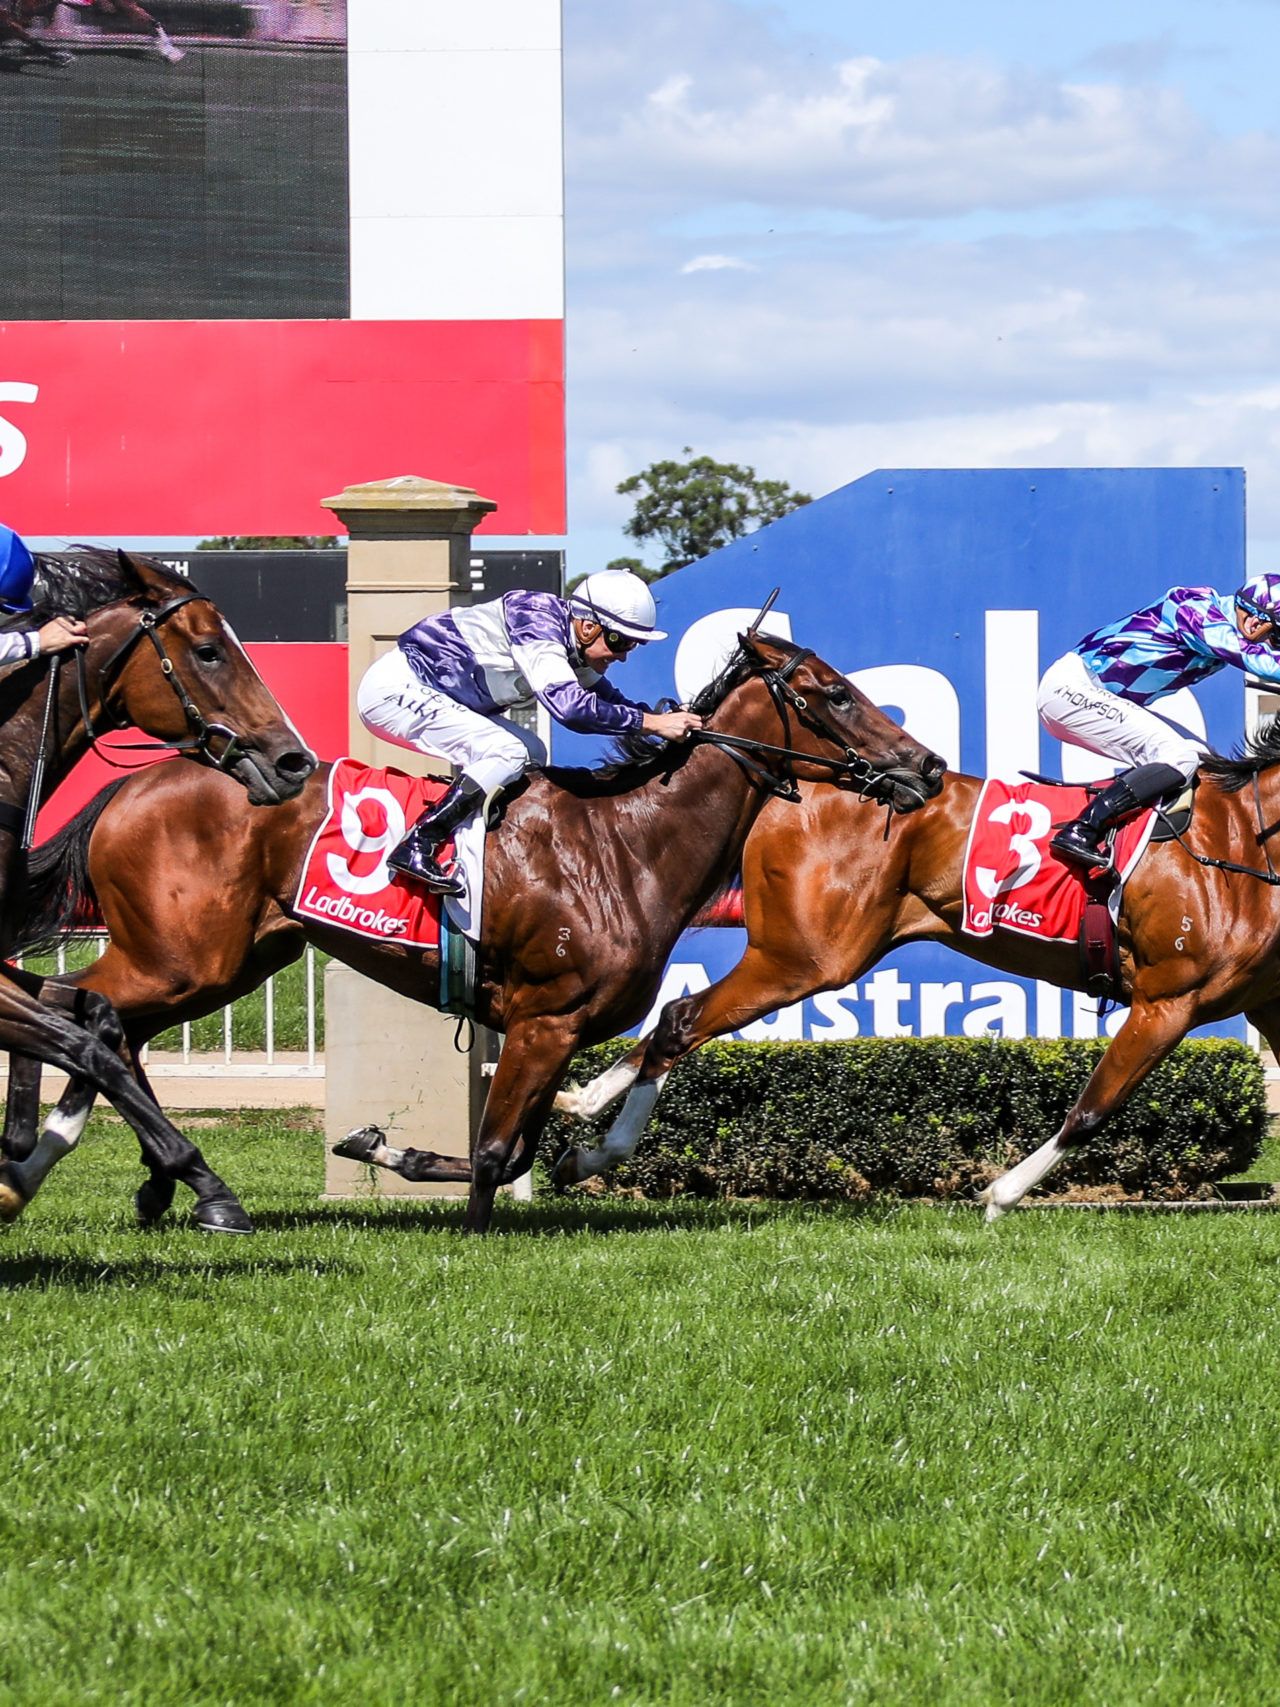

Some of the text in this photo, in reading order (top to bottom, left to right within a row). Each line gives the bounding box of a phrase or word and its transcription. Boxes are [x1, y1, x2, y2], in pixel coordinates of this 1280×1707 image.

[326, 786, 406, 895] 9
[975, 798, 1051, 898] 3
[304, 886, 409, 934] Ladbrokes
[969, 902, 1043, 927] Larokes
[558, 927, 570, 941] 3
[1181, 915, 1193, 932] 5
[555, 943, 566, 957] 6
[1174, 936, 1185, 951] 6
